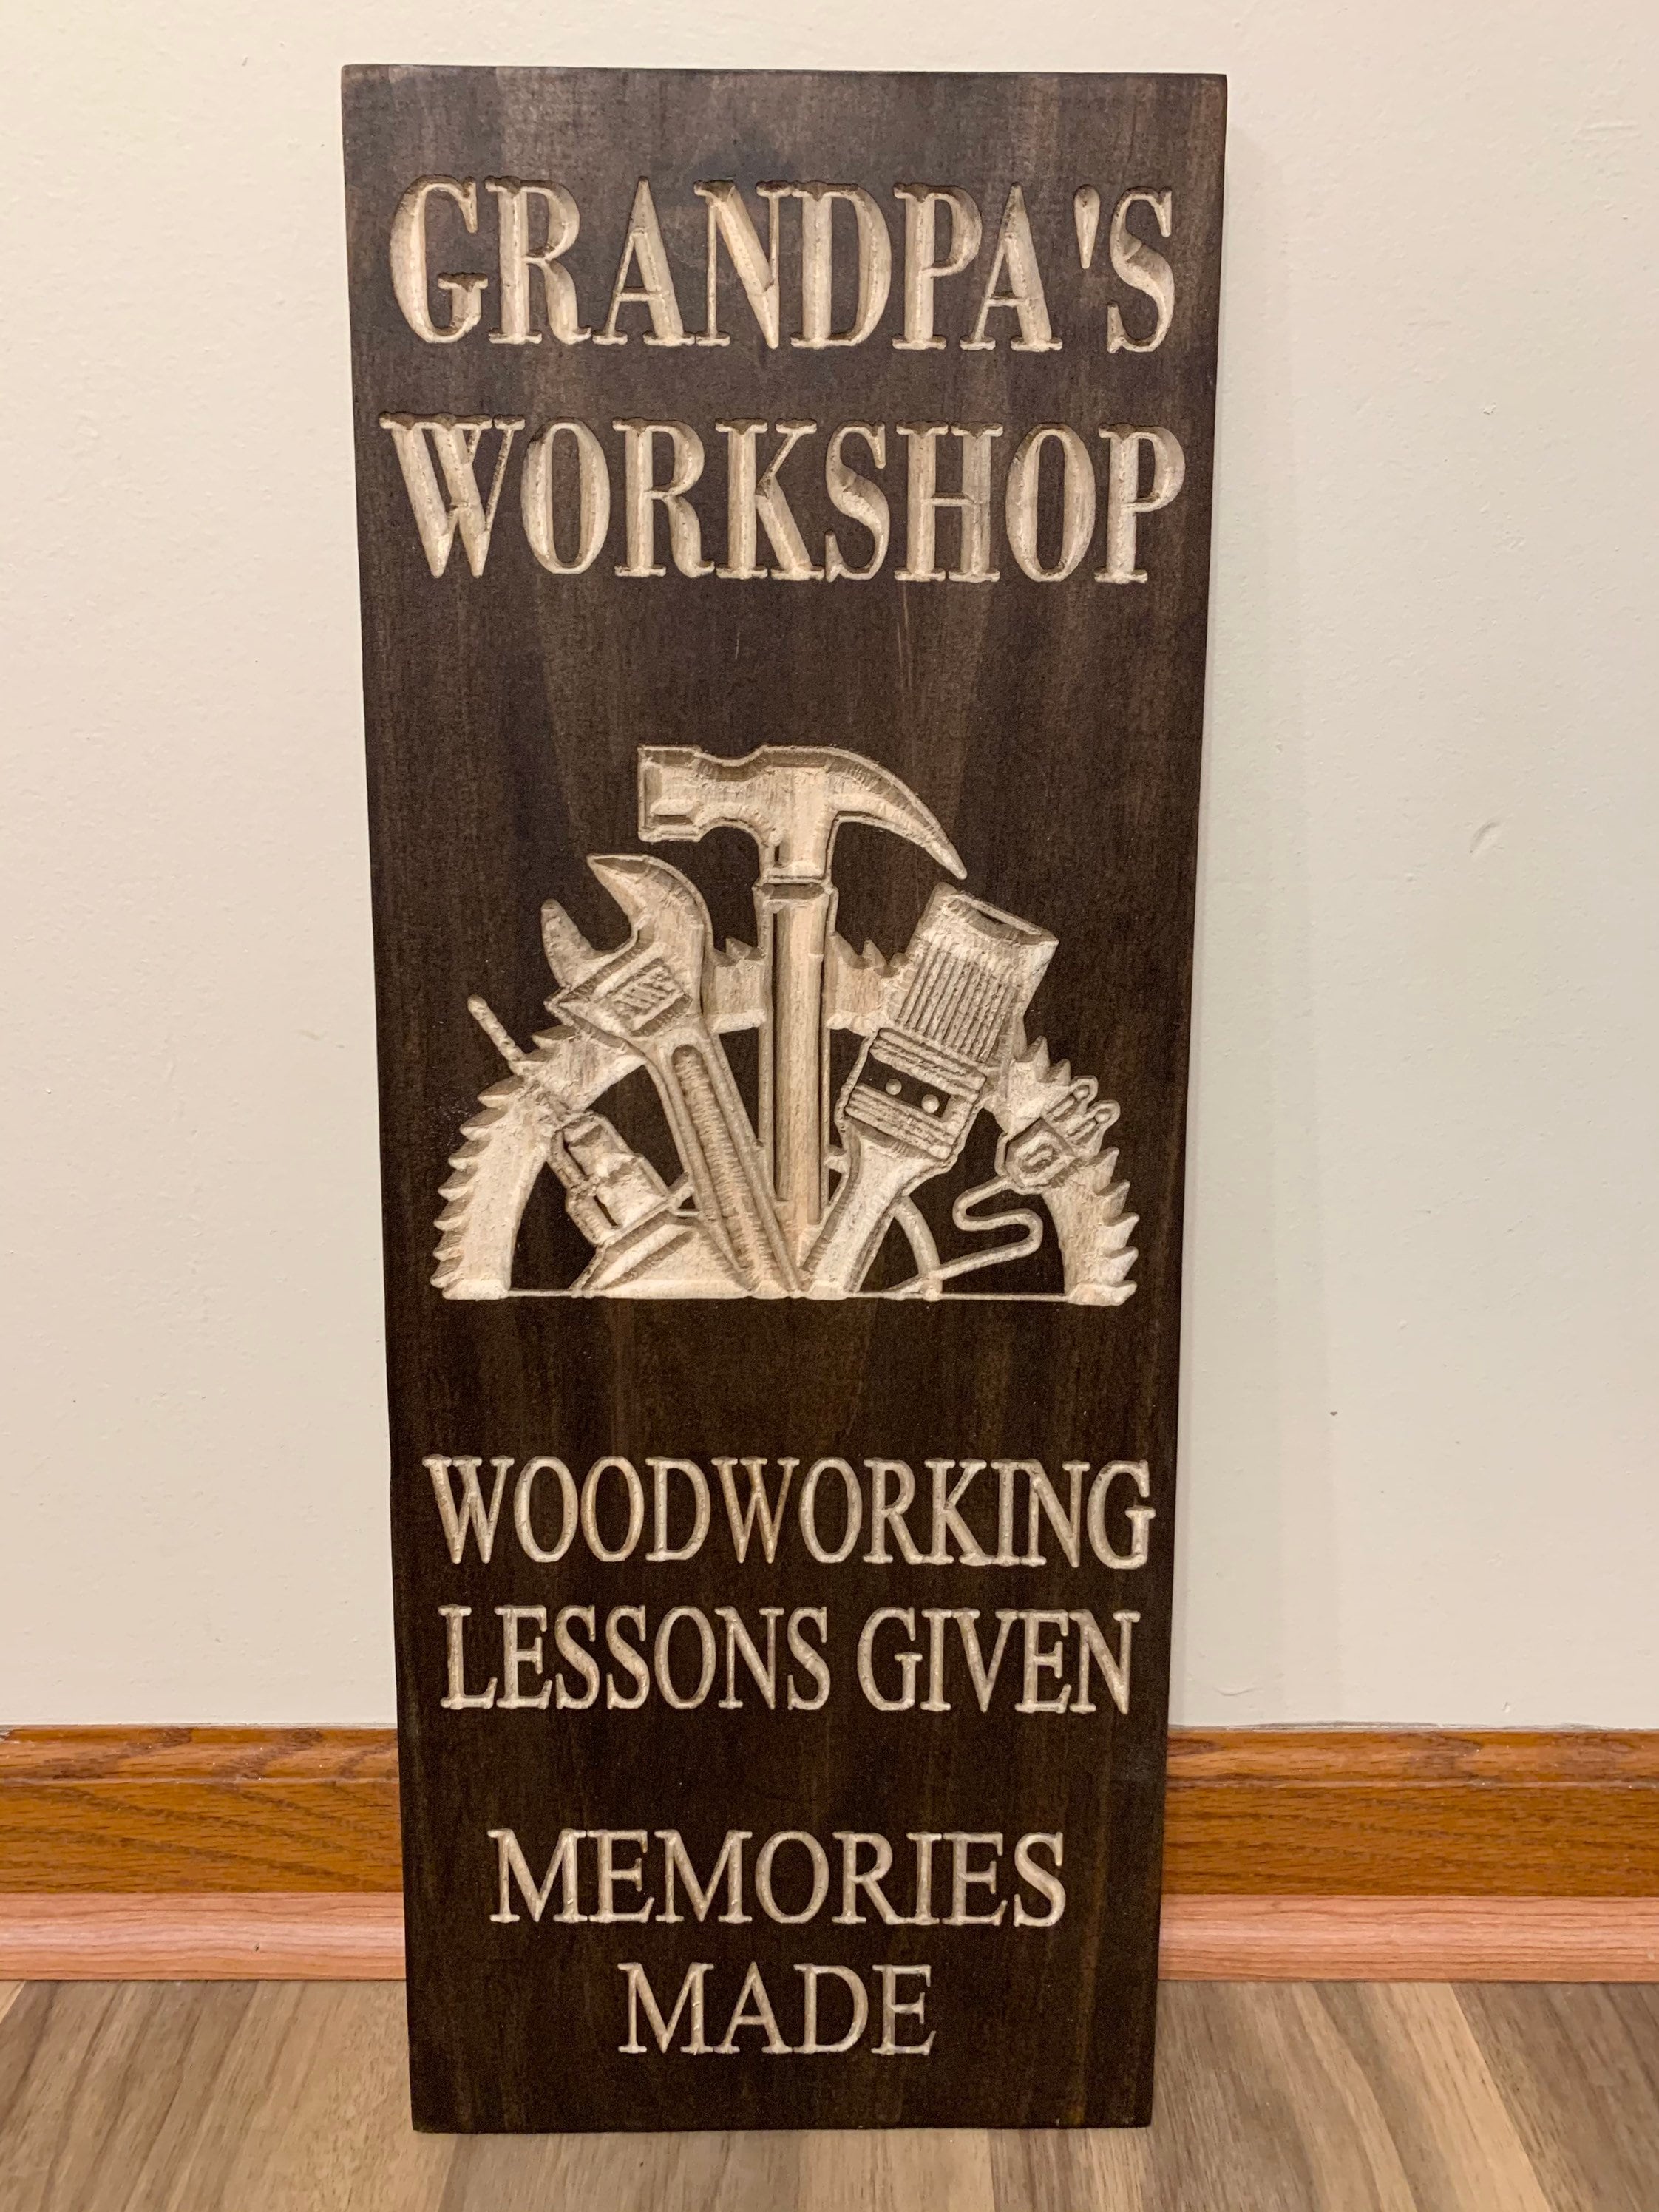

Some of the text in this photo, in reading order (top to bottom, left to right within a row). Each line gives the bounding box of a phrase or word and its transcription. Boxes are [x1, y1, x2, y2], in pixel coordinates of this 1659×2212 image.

[389, 175, 1175, 354] GRANDPA'S
[379, 414, 1186, 585] WORKSHOP
[422, 1455, 1156, 1570] WOODWORKING
[438, 1605, 1141, 1714] LESSONS GIVEN
[487, 1828, 1066, 1927] MEMORIES
[617, 1961, 936, 2055] MADE
